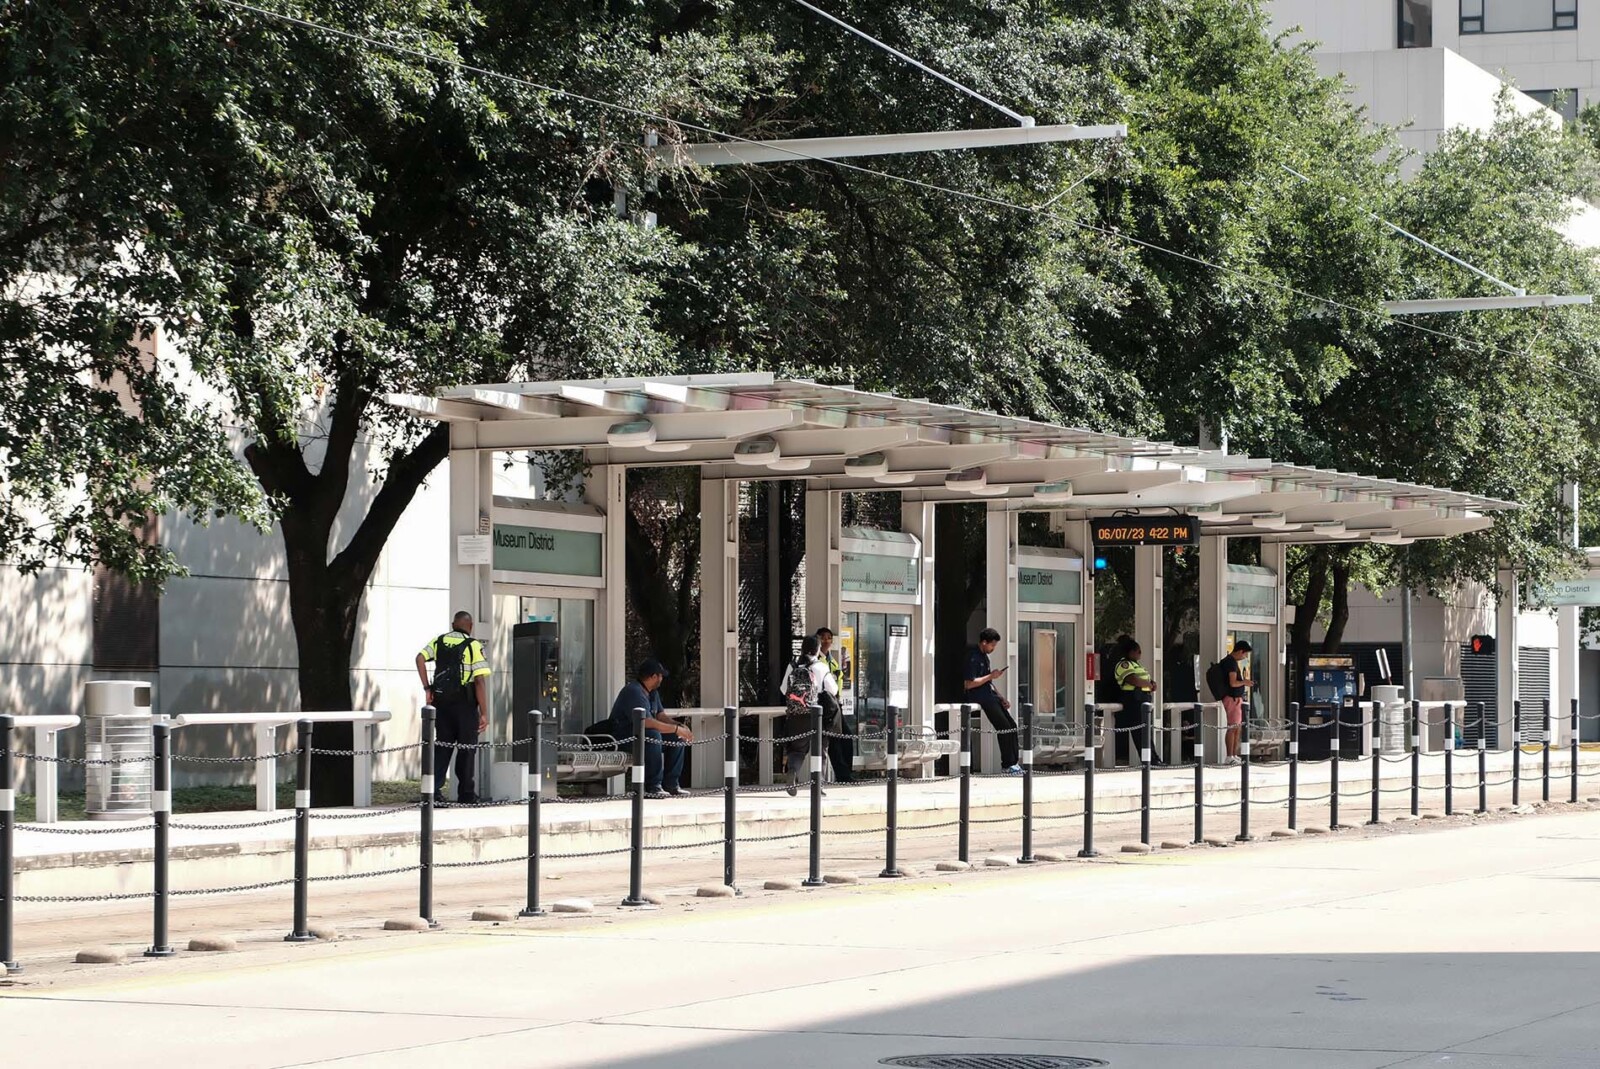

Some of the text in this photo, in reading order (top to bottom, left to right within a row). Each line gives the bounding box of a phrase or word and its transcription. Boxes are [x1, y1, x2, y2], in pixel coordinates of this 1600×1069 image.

[493, 527, 555, 551] Museum District
[1098, 527, 1188, 540] 06/07/23 4:22 PM
[1565, 584, 1591, 593] District
